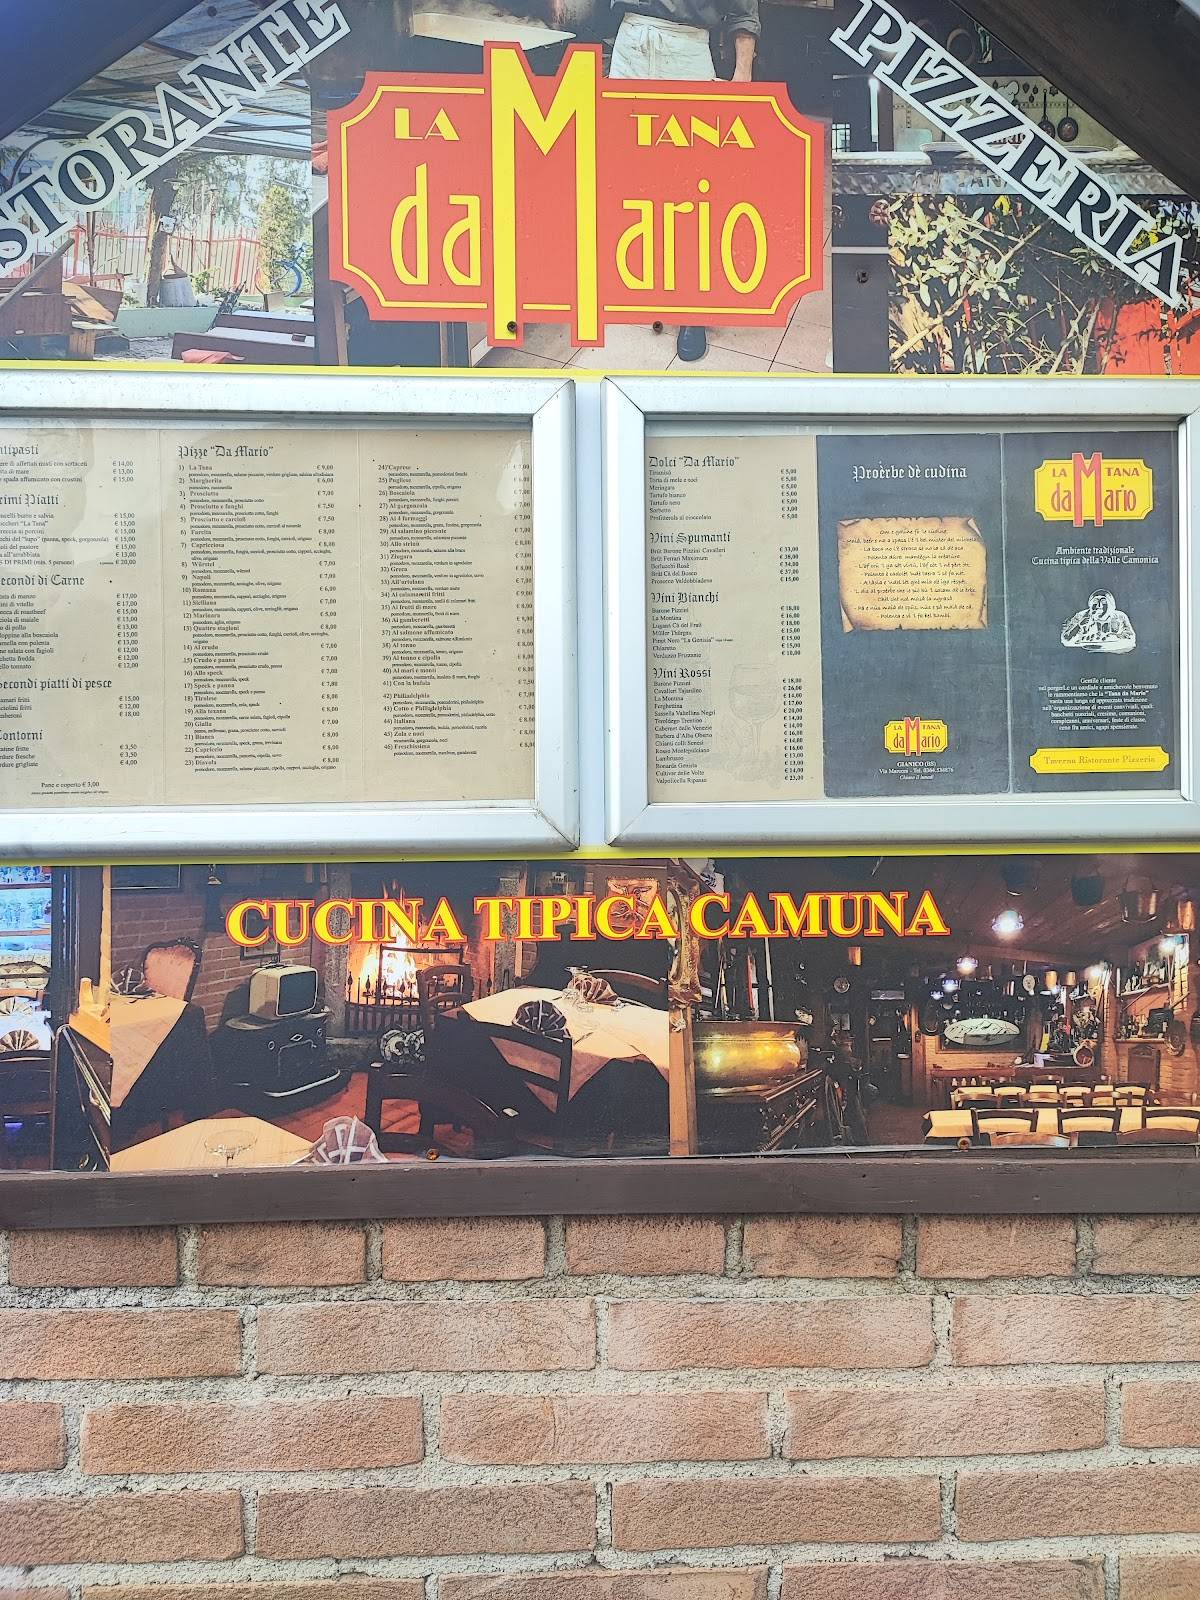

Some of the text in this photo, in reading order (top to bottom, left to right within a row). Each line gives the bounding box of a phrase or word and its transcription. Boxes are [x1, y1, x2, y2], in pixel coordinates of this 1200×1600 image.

[394, 107, 755, 150] LA TANA
[834, 0, 1187, 302] PIZZERIA
[390, 47, 768, 342] da Mario
[178, 445, 273, 459] Pizze "Da Mario"
[649, 456, 740, 467] Dolci "Da Mario"
[852, 464, 967, 482] Proèrbe dè cudina
[1052, 467, 1140, 478] LA TANA
[1051, 452, 1137, 527] da Mario
[25, 494, 59, 507] Piatti
[650, 531, 731, 544] Vini Spumanti
[1056, 546, 1134, 555] Ambiente tradizionale
[1031, 555, 1159, 566] Cucina tipica della Valle Camonica
[1, 574, 85, 585] econdi di Carne
[651, 592, 719, 605] Vini Bianchi
[653, 668, 711, 679] Vini Rossi
[40, 678, 69, 690] piatti
[73, 678, 82, 688] di
[85, 679, 112, 690] pesce
[893, 717, 941, 756] da Mario
[1044, 755, 1155, 765] Taverna Ristorante Pizzeria
[224, 889, 952, 947] CUCINA TIPICA CAMUNA
